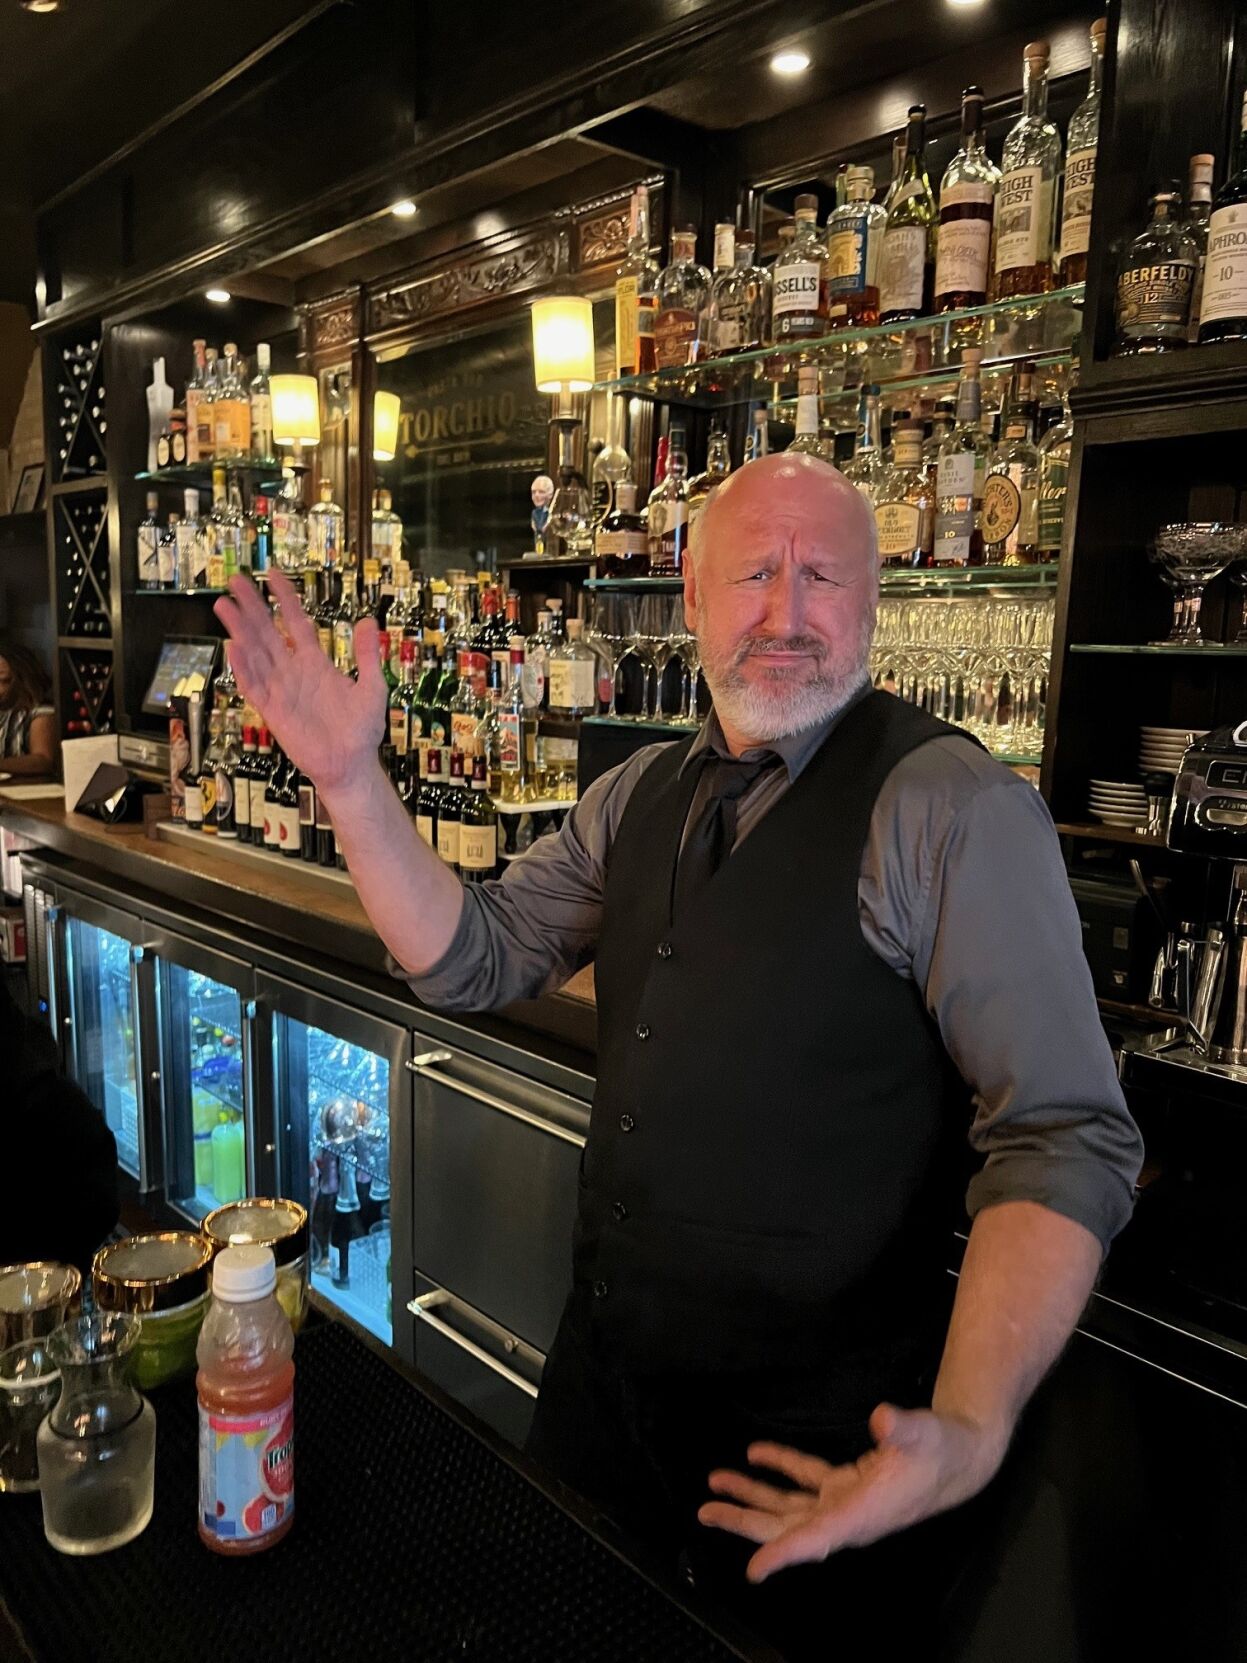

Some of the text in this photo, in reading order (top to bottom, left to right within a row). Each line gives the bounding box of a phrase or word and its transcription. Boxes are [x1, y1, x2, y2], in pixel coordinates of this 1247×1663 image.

[1208, 231, 1247, 253] APHRO
[1219, 265, 1234, 282] 10
[775, 276, 817, 296] SSELL'S
[1143, 292, 1159, 305] 12
[781, 318, 790, 333] 6
[400, 391, 516, 445] TORCHIO
[1040, 481, 1069, 500] ller
[944, 530, 956, 539] 10
